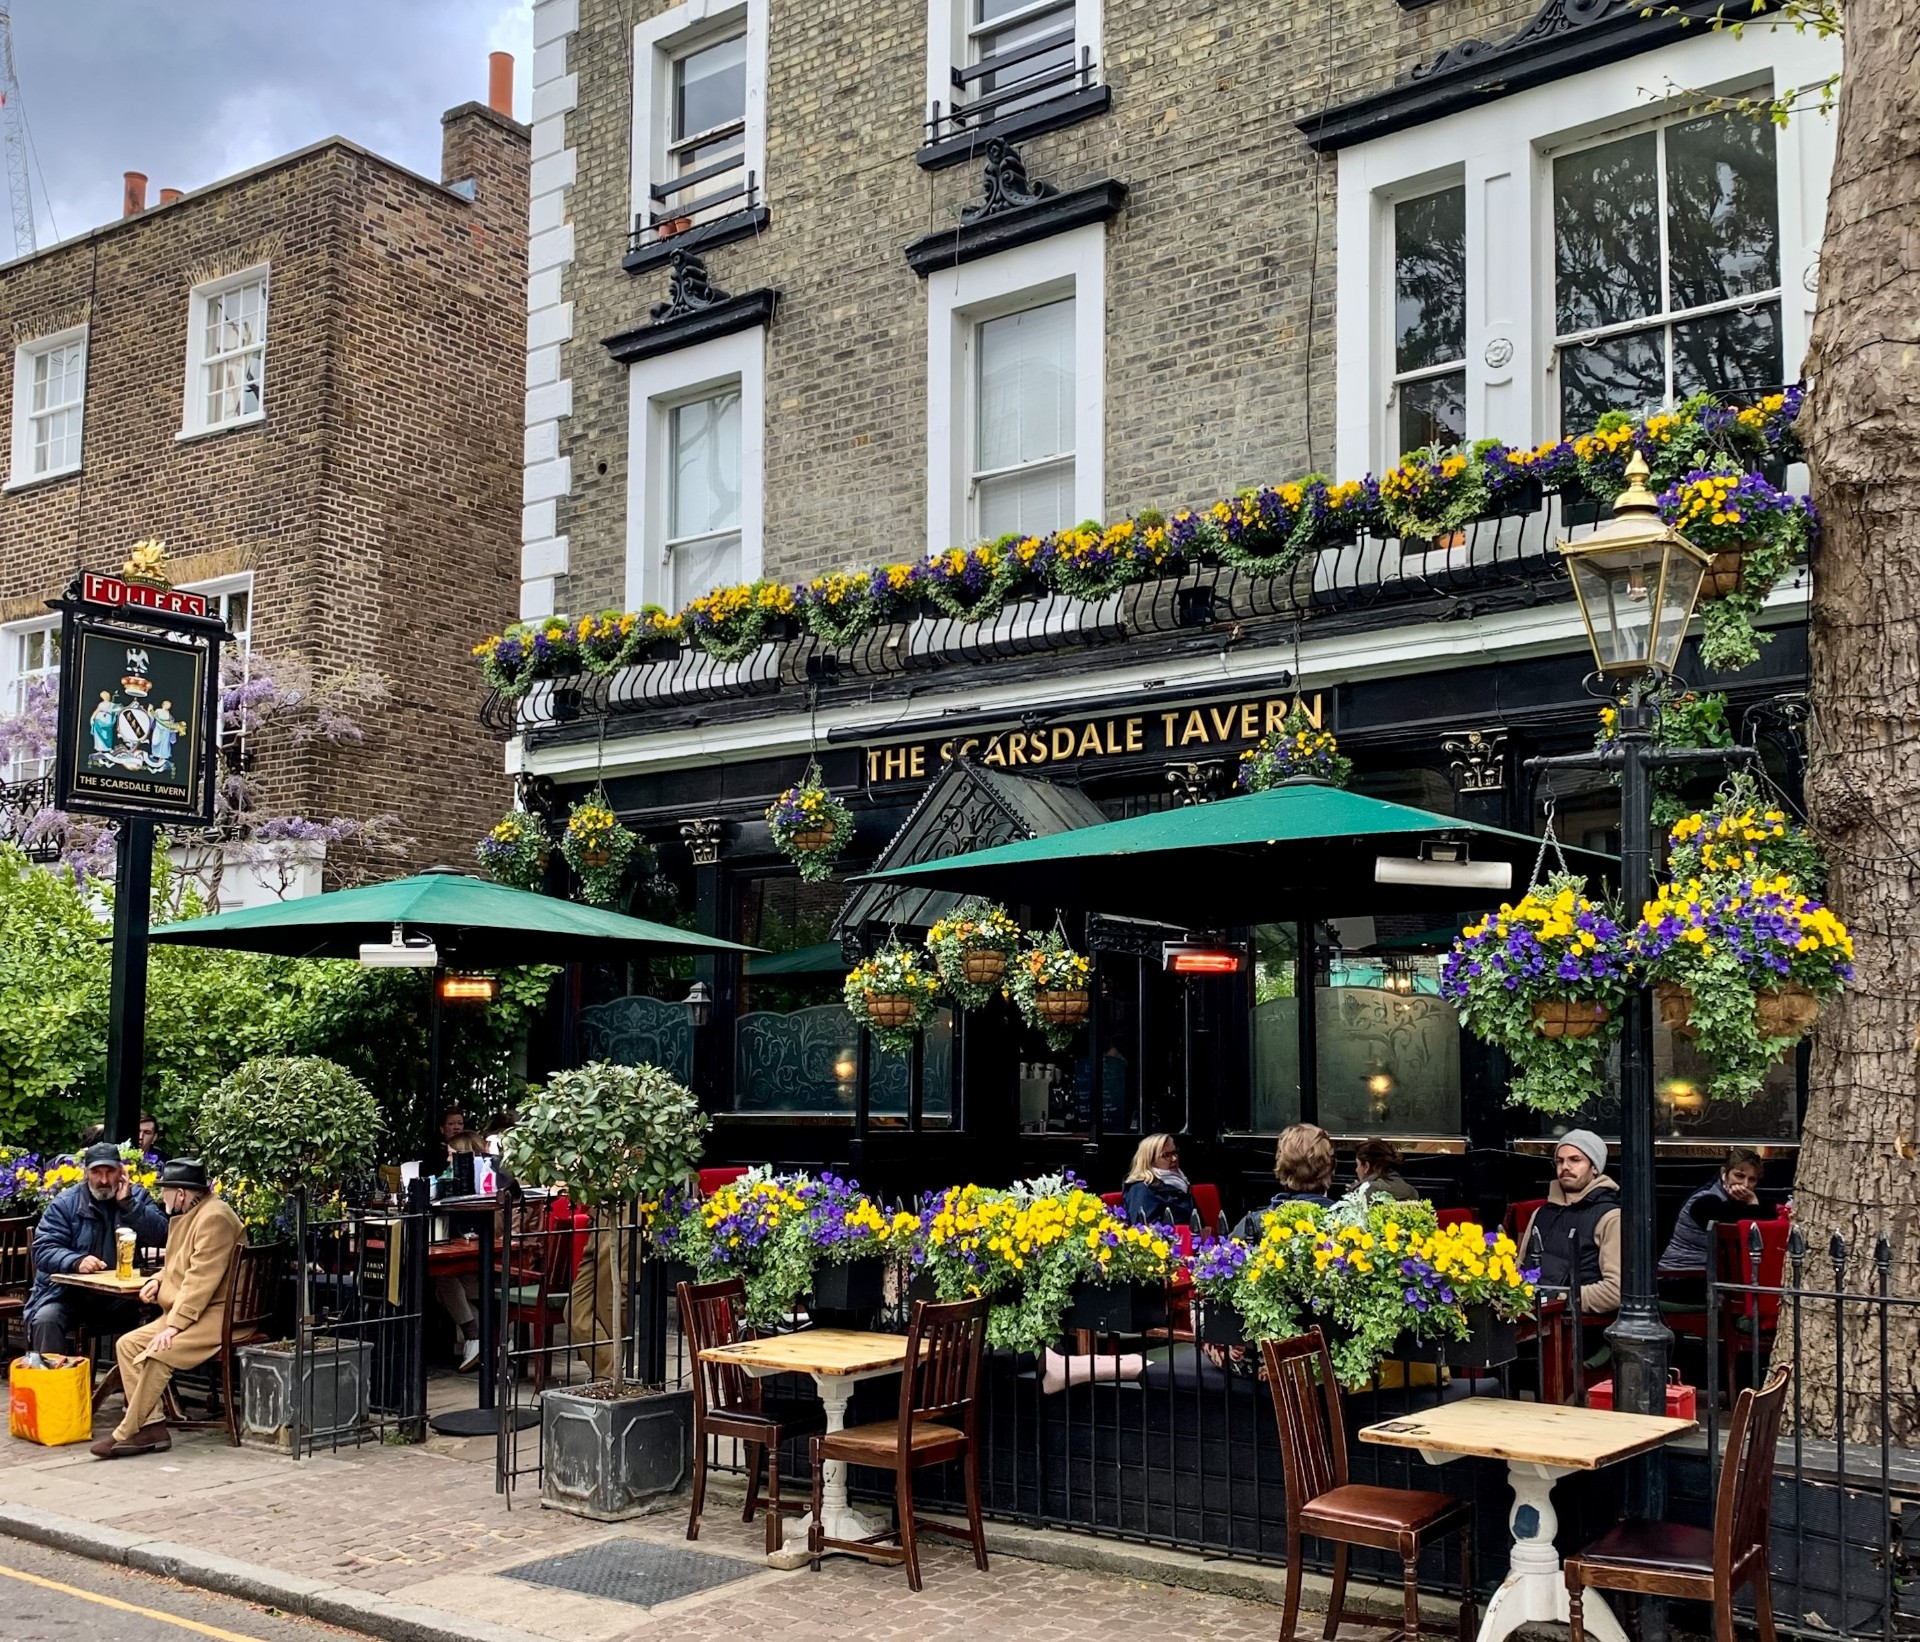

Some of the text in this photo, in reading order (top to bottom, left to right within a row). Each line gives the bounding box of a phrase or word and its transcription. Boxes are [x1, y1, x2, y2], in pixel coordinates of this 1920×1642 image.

[91, 577, 199, 615] FULLER'S
[868, 745, 925, 782] THE
[1161, 693, 1322, 747] TAVERN
[80, 776, 186, 797] THE SCARSDALE TAVERN
